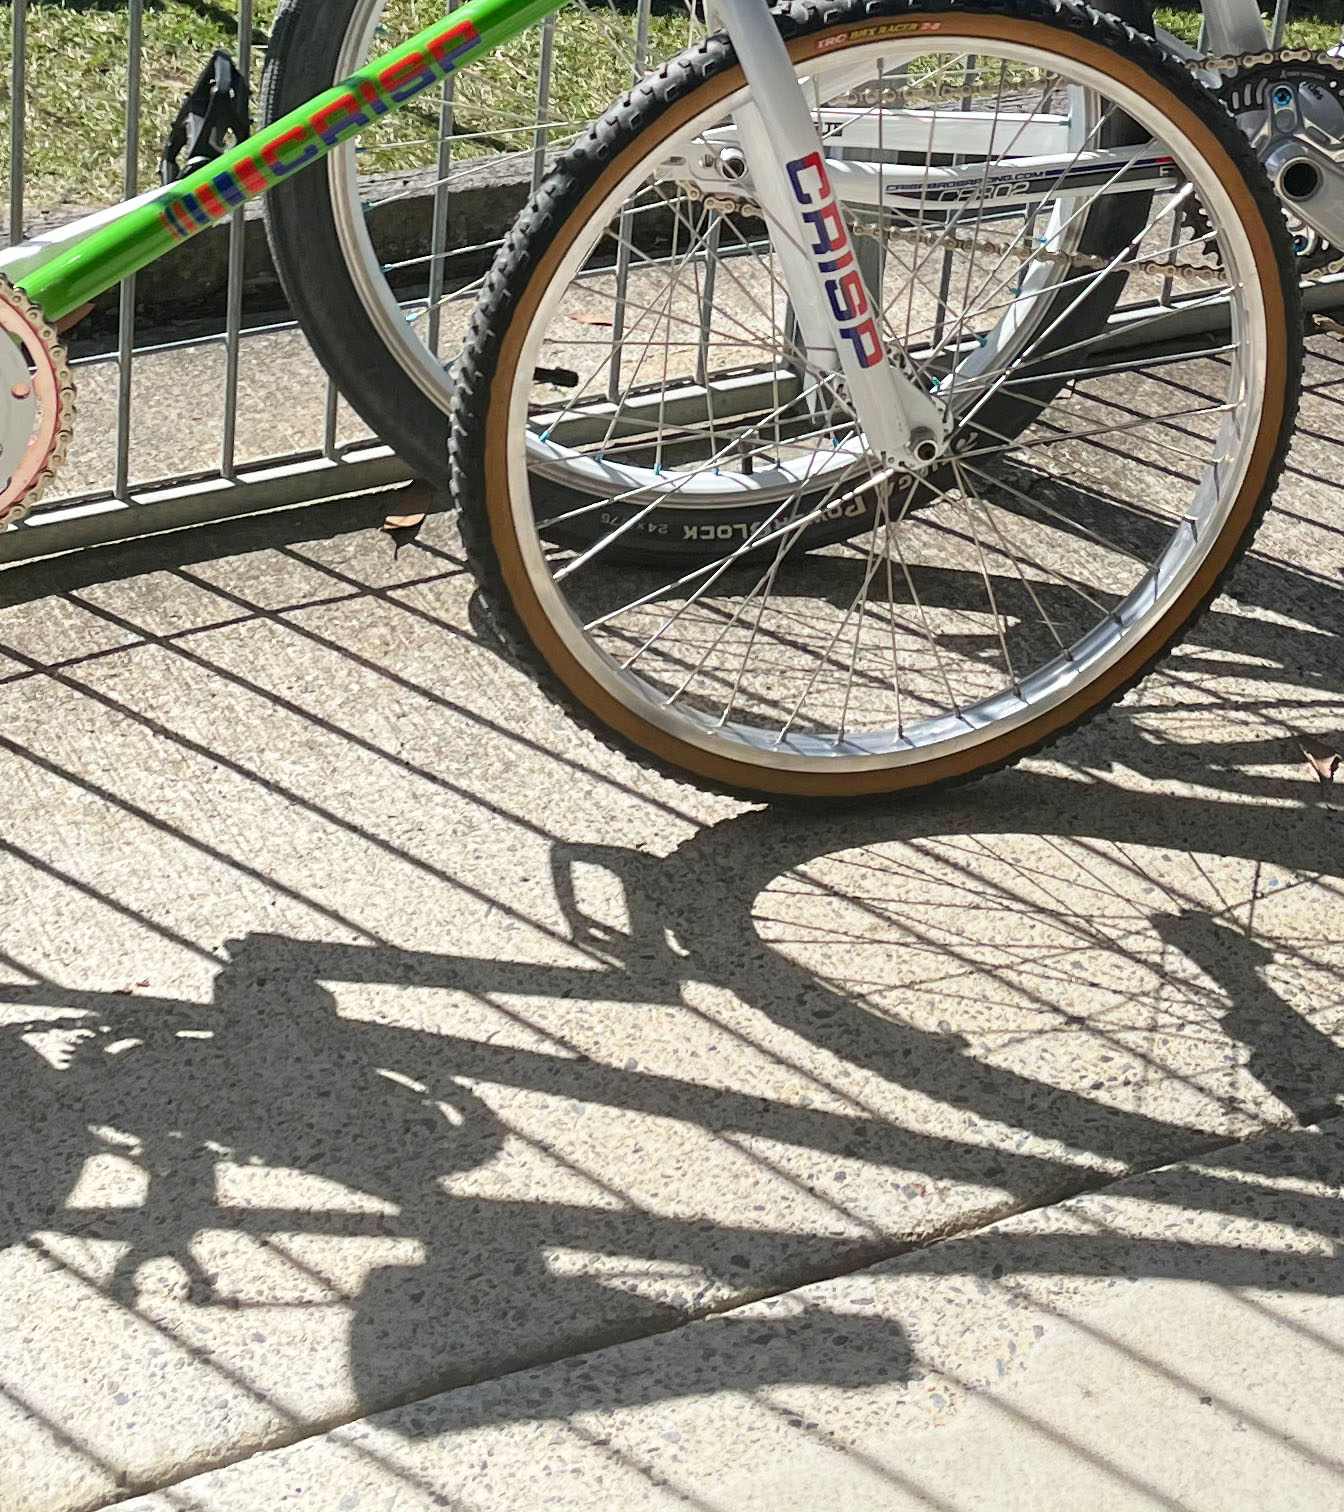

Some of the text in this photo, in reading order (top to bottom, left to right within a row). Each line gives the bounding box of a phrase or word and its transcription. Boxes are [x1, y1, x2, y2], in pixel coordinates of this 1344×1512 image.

[261, 19, 482, 177] CRISP
[786, 151, 884, 370] CRISP
[682, 495, 868, 541] POWRBLOCK
